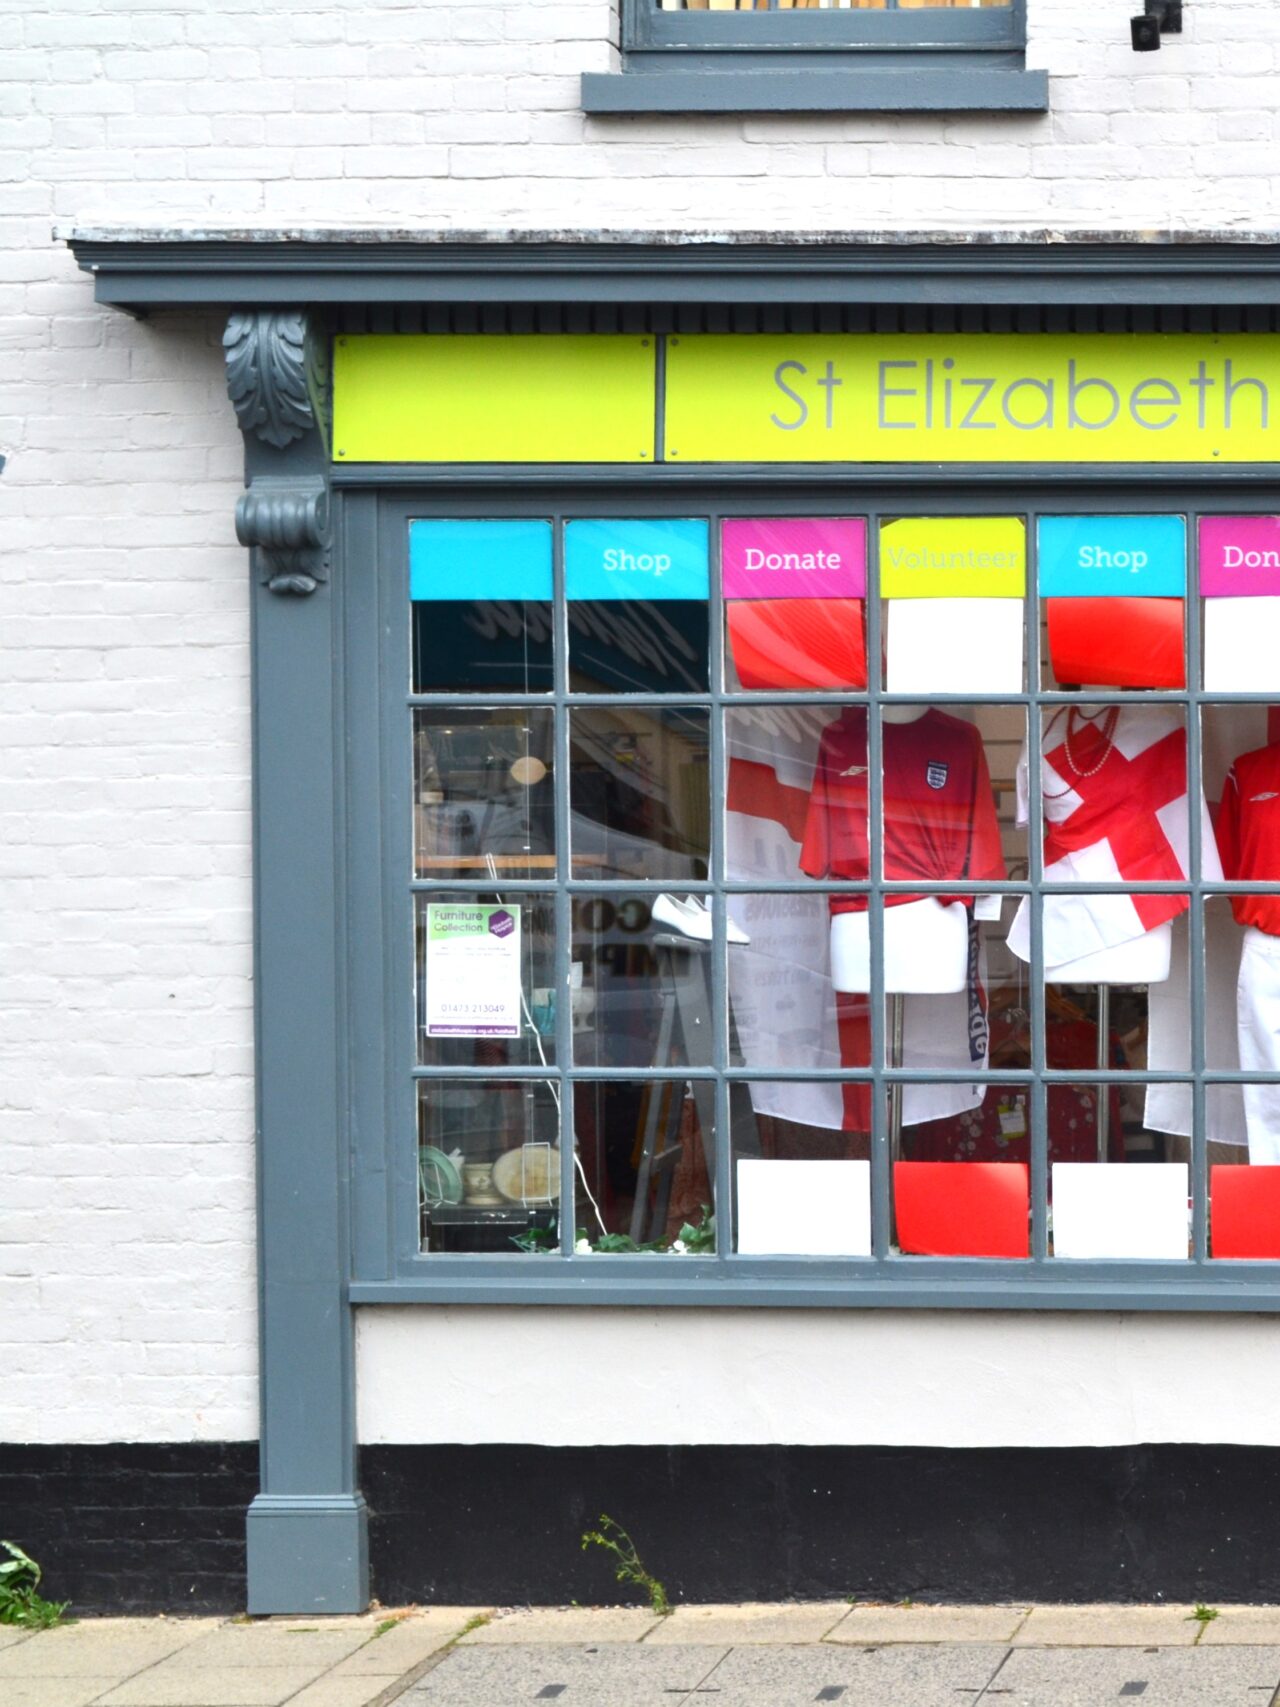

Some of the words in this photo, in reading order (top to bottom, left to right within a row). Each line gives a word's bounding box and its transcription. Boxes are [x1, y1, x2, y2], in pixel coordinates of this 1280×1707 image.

[770, 360, 843, 431] St
[876, 359, 1271, 431] Elizabeth
[602, 549, 672, 576] Shop
[745, 548, 841, 571] Donate
[887, 546, 1019, 571] Volunteer
[1078, 546, 1148, 573] Shop
[434, 910, 483, 921] Furniture
[434, 923, 483, 933] Collection
